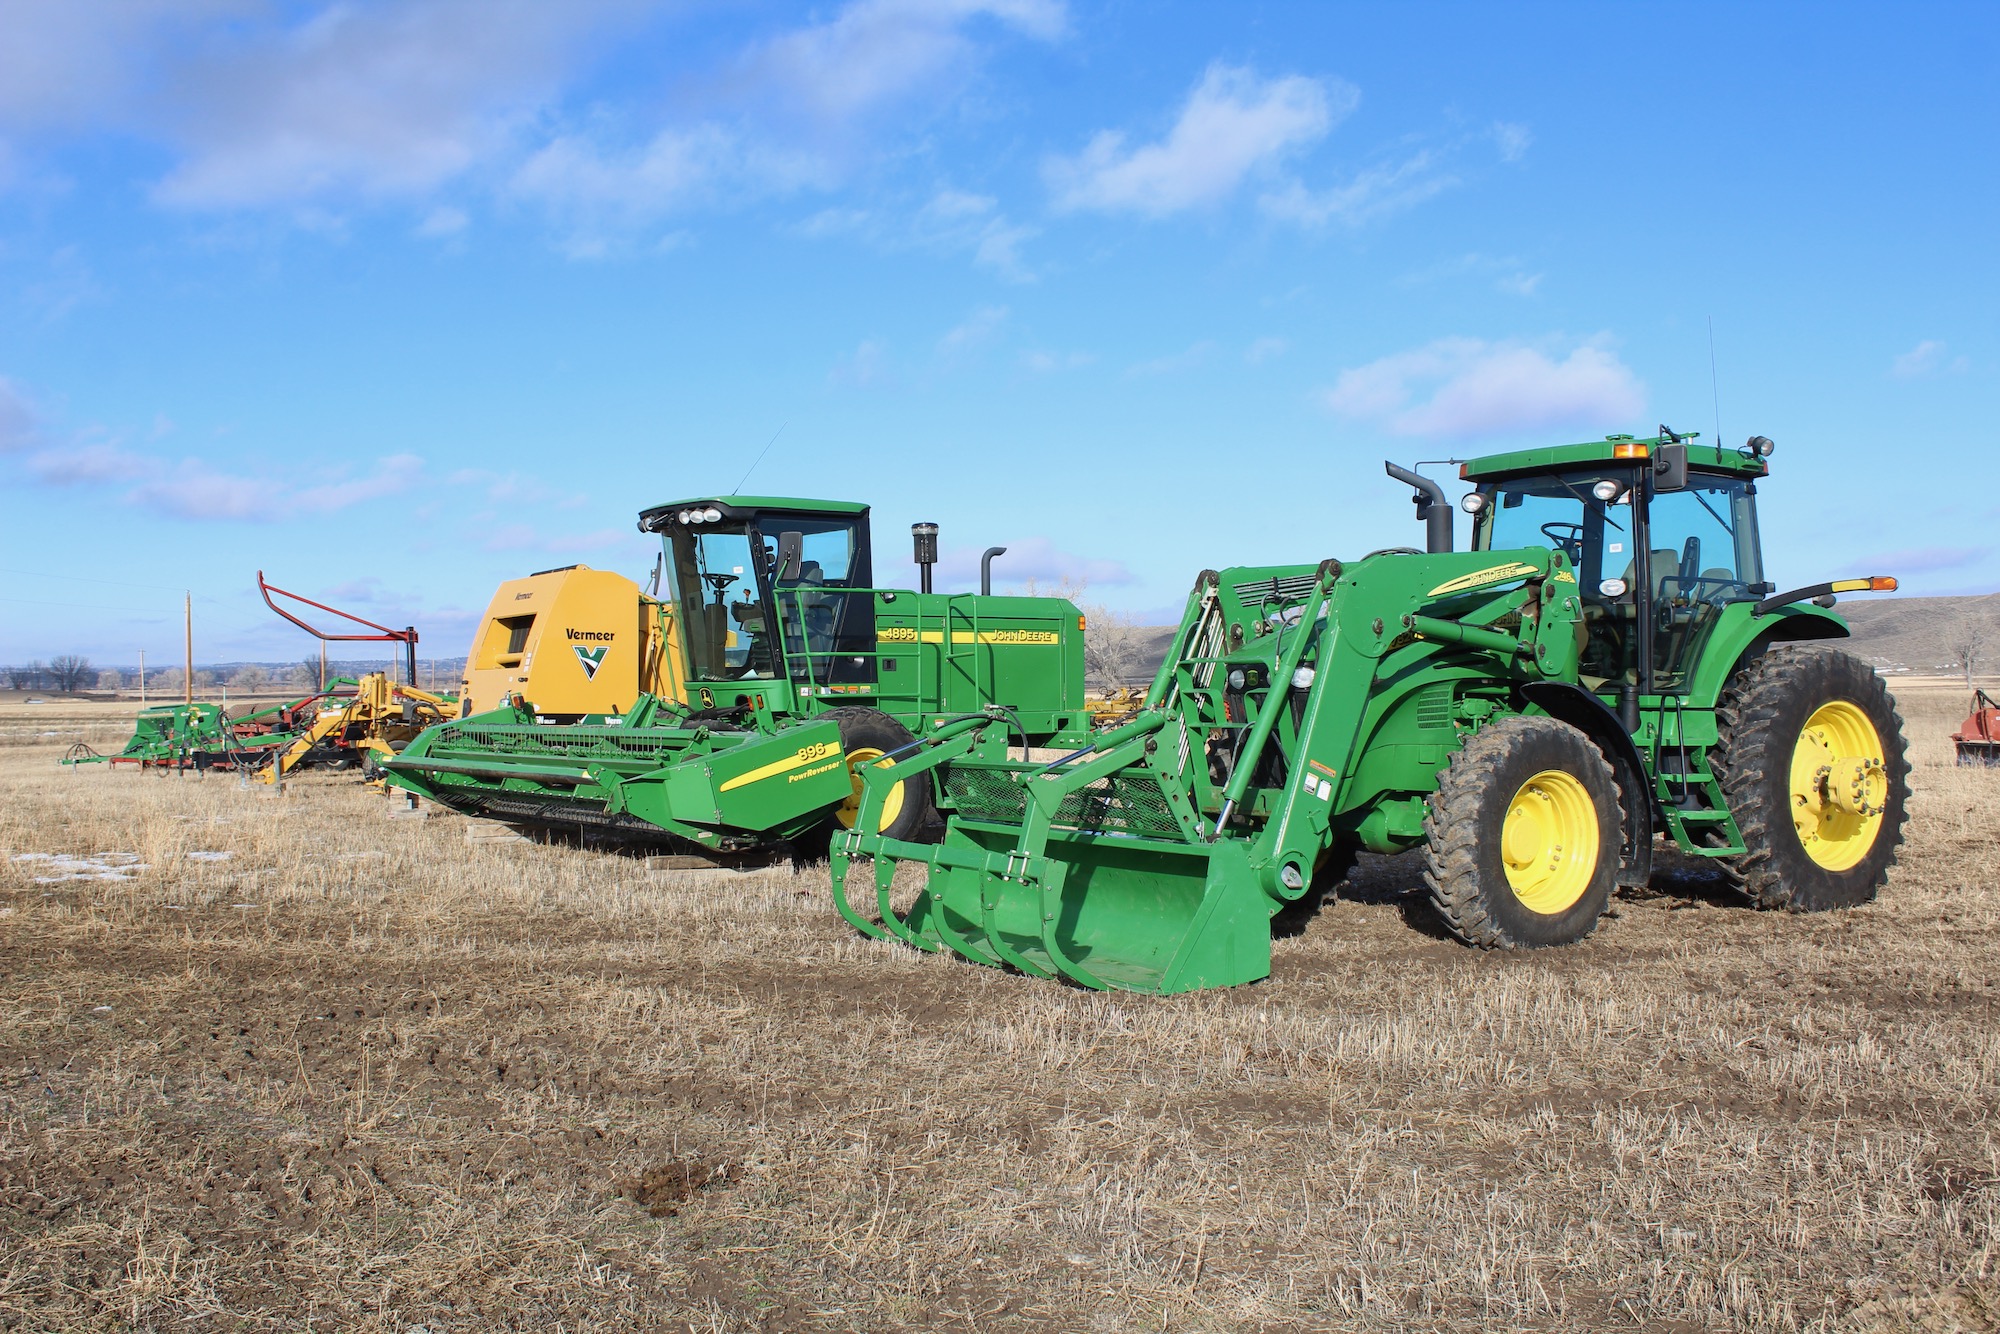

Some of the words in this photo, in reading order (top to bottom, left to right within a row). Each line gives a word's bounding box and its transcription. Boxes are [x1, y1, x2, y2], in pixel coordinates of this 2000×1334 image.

[1557, 570, 1572, 581] 746
[566, 628, 615, 641] Vermeer
[885, 628, 915, 640] 4895
[991, 629, 1018, 642] JOHN
[1018, 629, 1052, 642] DEERE
[797, 742, 826, 761] 896
[788, 761, 840, 784] PowrReverser
